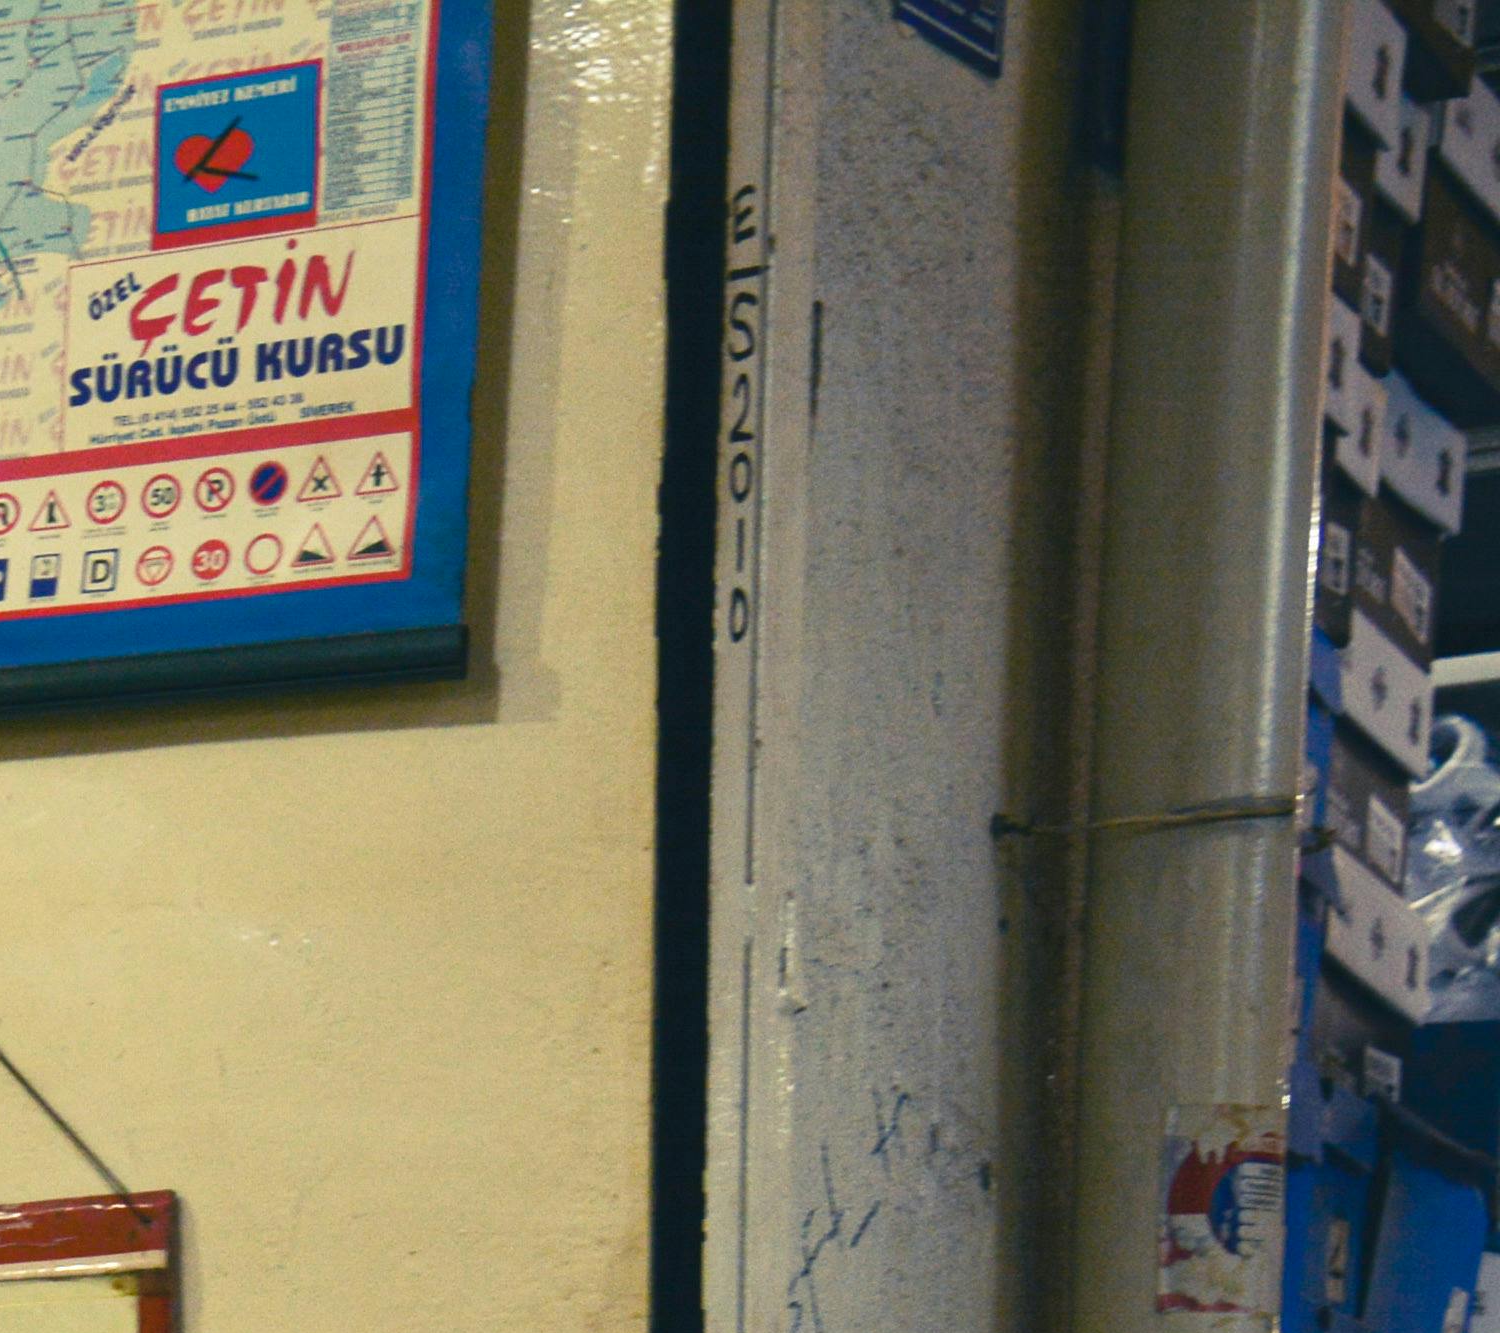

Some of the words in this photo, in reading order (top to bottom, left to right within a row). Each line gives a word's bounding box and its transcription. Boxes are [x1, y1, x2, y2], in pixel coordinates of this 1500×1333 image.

[88, 272, 142, 321] ÖZEL
[128, 238, 357, 359] ÇETİN
[69, 336, 240, 408] SÜRÜCÜ
[255, 324, 406, 383] KURSU
